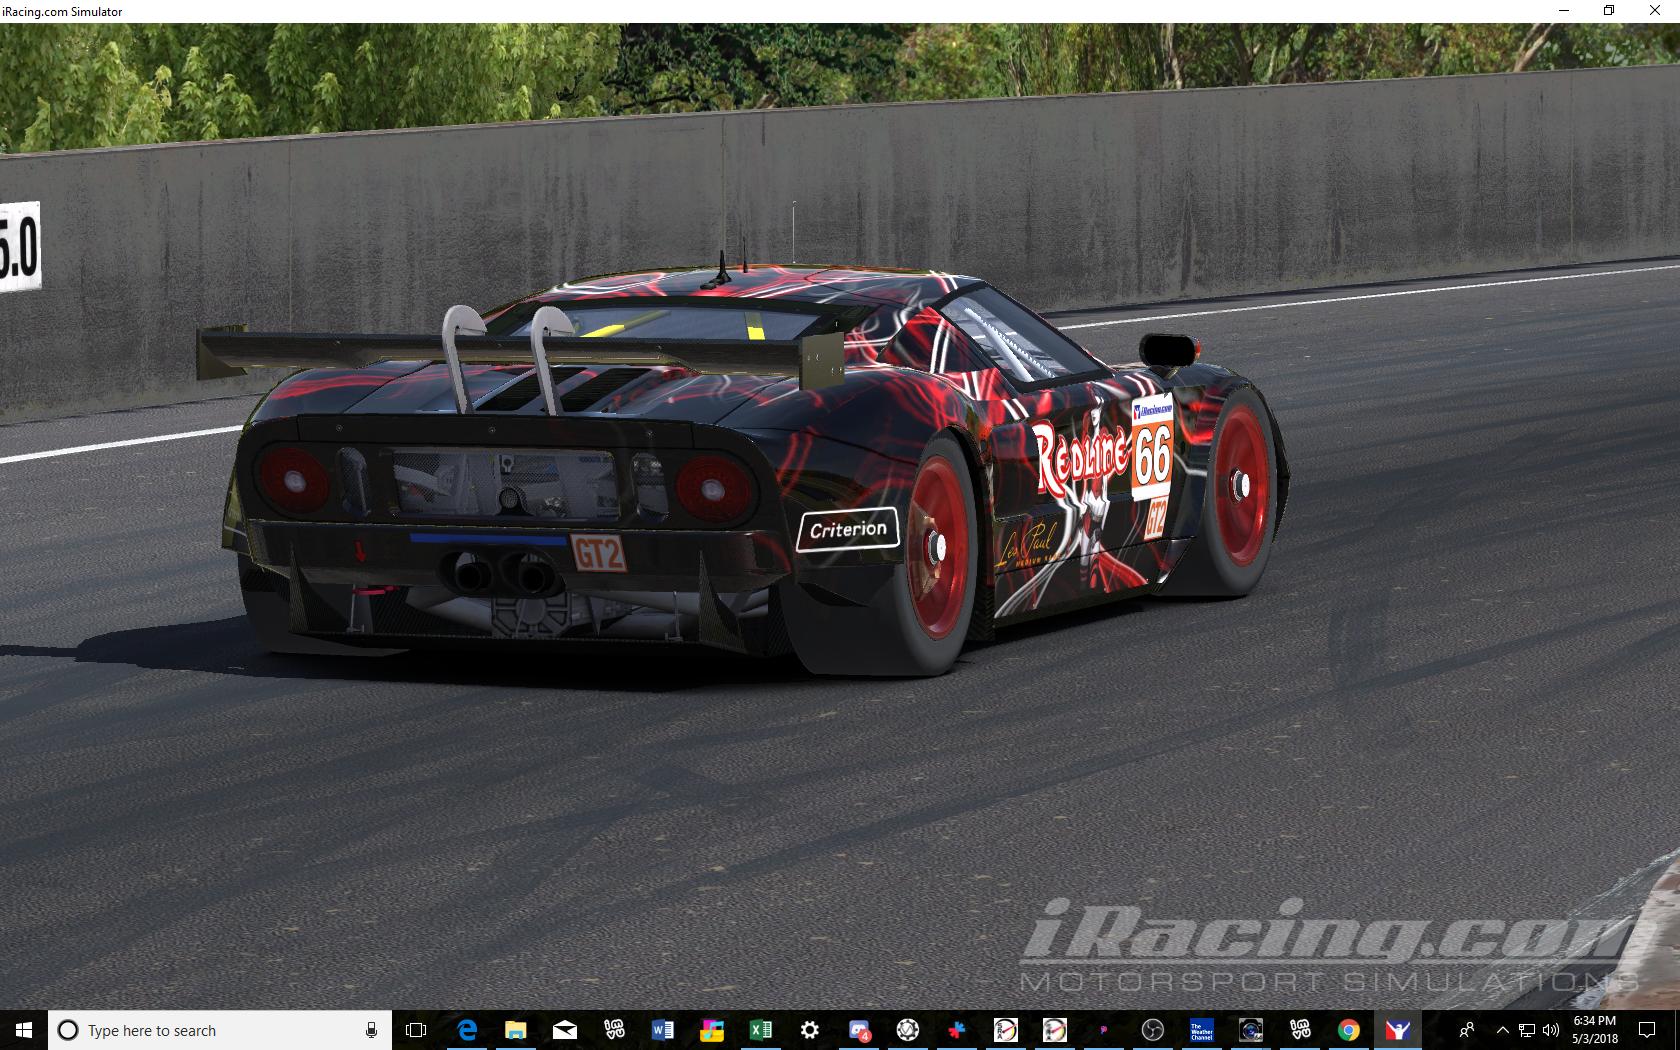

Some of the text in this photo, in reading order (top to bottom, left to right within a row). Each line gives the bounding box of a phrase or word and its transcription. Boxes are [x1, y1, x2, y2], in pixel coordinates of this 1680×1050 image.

[2, 6, 123, 19] iRacing.com Simulator
[1135, 424, 1171, 486] 66
[1146, 500, 1167, 534] GT2
[810, 520, 887, 539] Criterion
[1021, 521, 1058, 559] Paul
[576, 538, 623, 568] GT2
[1574, 1015, 1616, 1026] 6:34 PM
[88, 1024, 216, 1039] Type here to search
[1572, 1033, 1619, 1045] 5/3/2018
